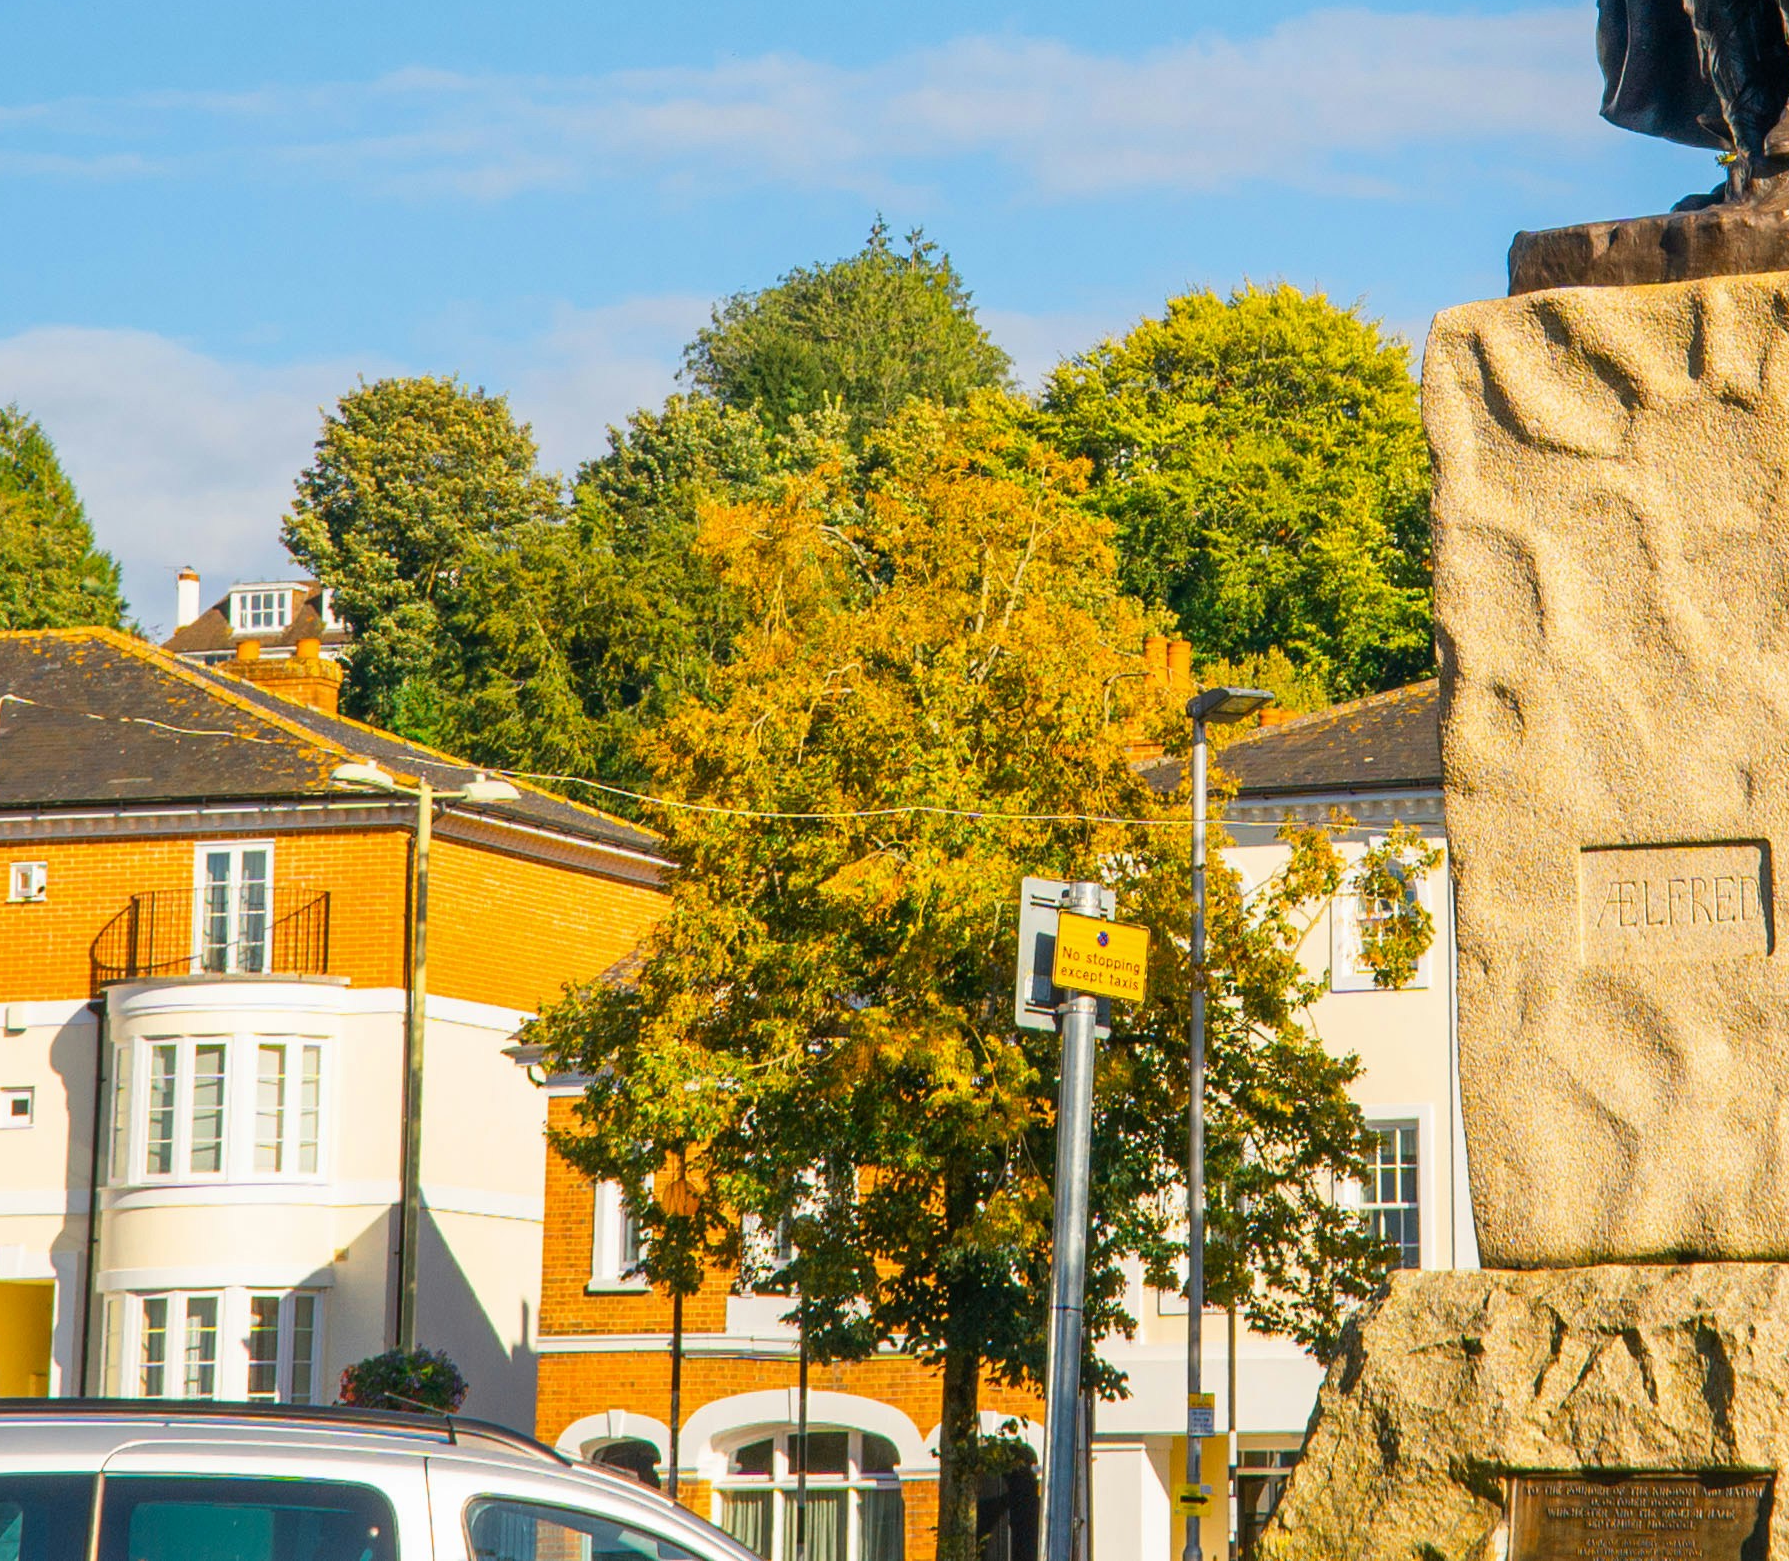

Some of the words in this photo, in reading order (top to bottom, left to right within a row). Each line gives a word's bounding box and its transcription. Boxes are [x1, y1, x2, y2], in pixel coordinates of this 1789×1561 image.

[1062, 946, 1080, 961] No
[1086, 953, 1141, 976] stopping
[1061, 966, 1103, 983] except
[1109, 973, 1139, 991] taxis
